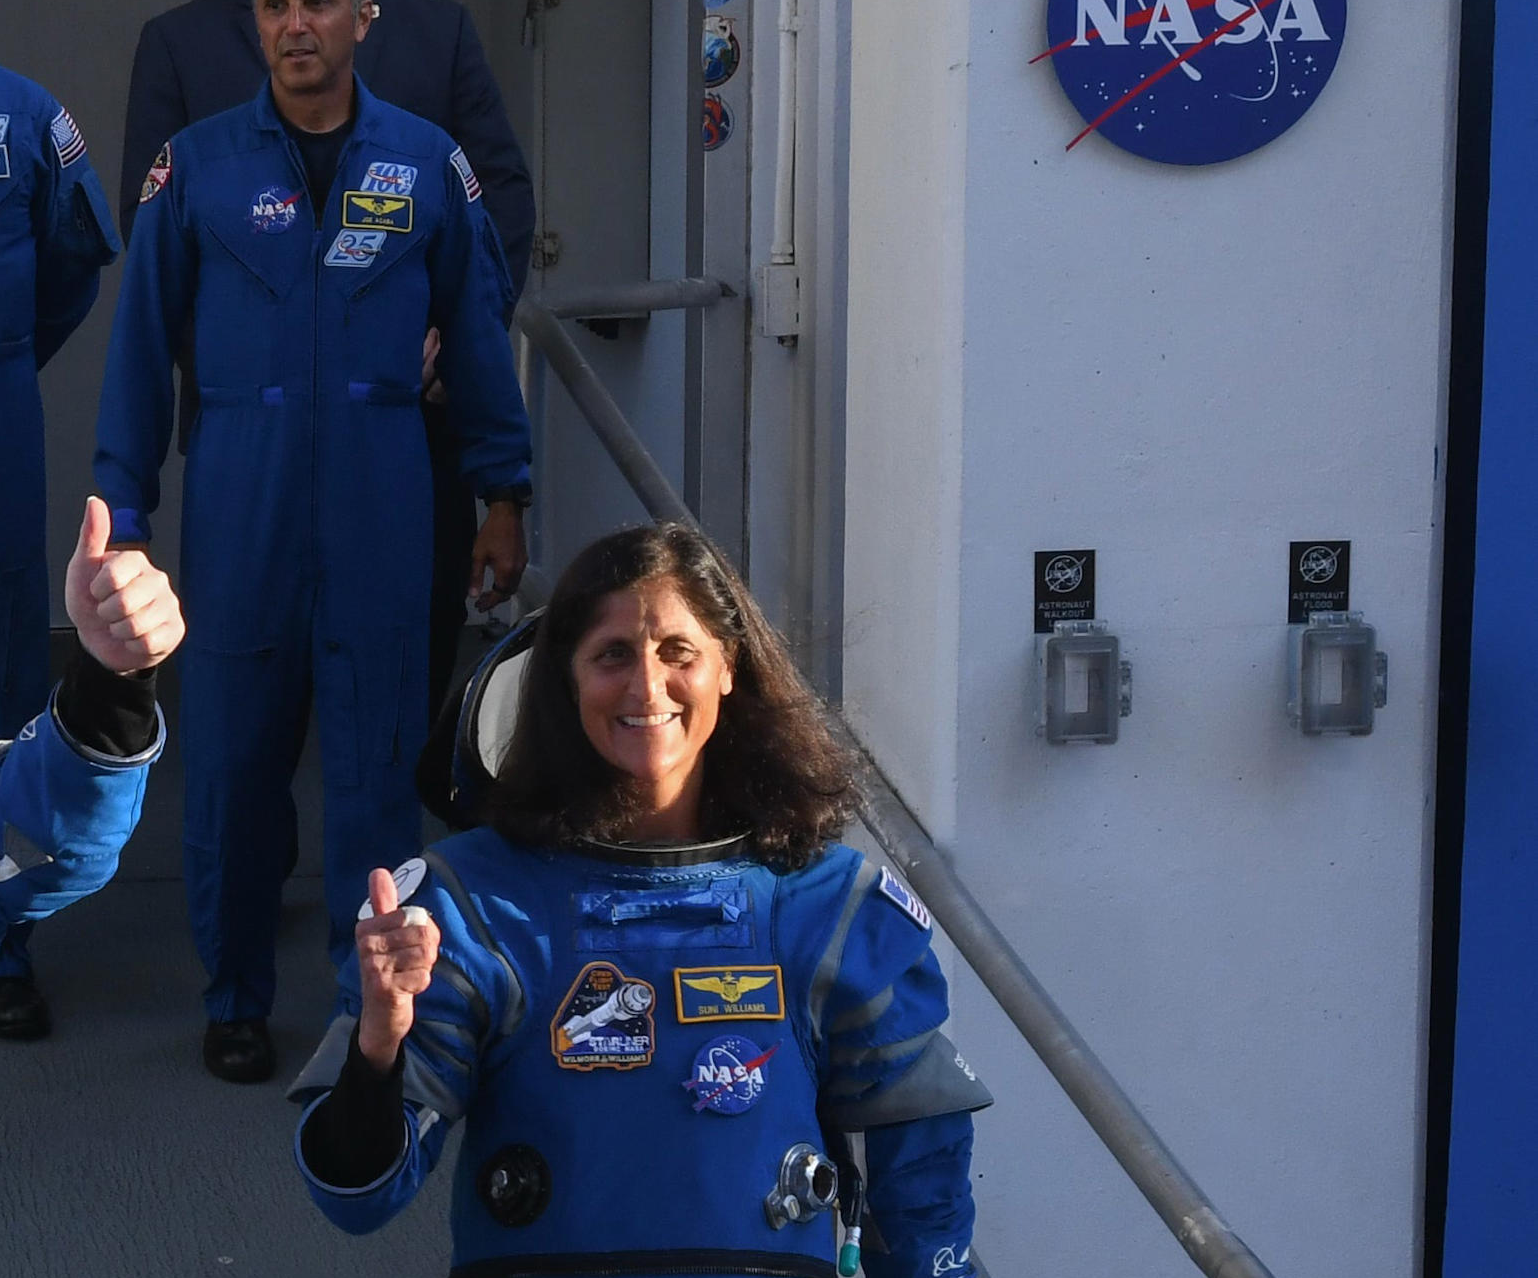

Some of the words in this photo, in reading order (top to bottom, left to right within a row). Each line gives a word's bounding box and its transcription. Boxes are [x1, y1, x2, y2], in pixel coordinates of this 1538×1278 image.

[367, 165, 414, 193] 100
[253, 202, 296, 216] NASA
[333, 234, 377, 261] 25
[1293, 591, 1344, 600] ASTRONAUT
[1038, 600, 1090, 610] ASTRONAUT
[1044, 610, 1085, 618] WALKOUT
[698, 1005, 719, 1014] SUNI
[724, 1004, 765, 1013] WILLIAMS
[698, 1065, 764, 1084] NASA
